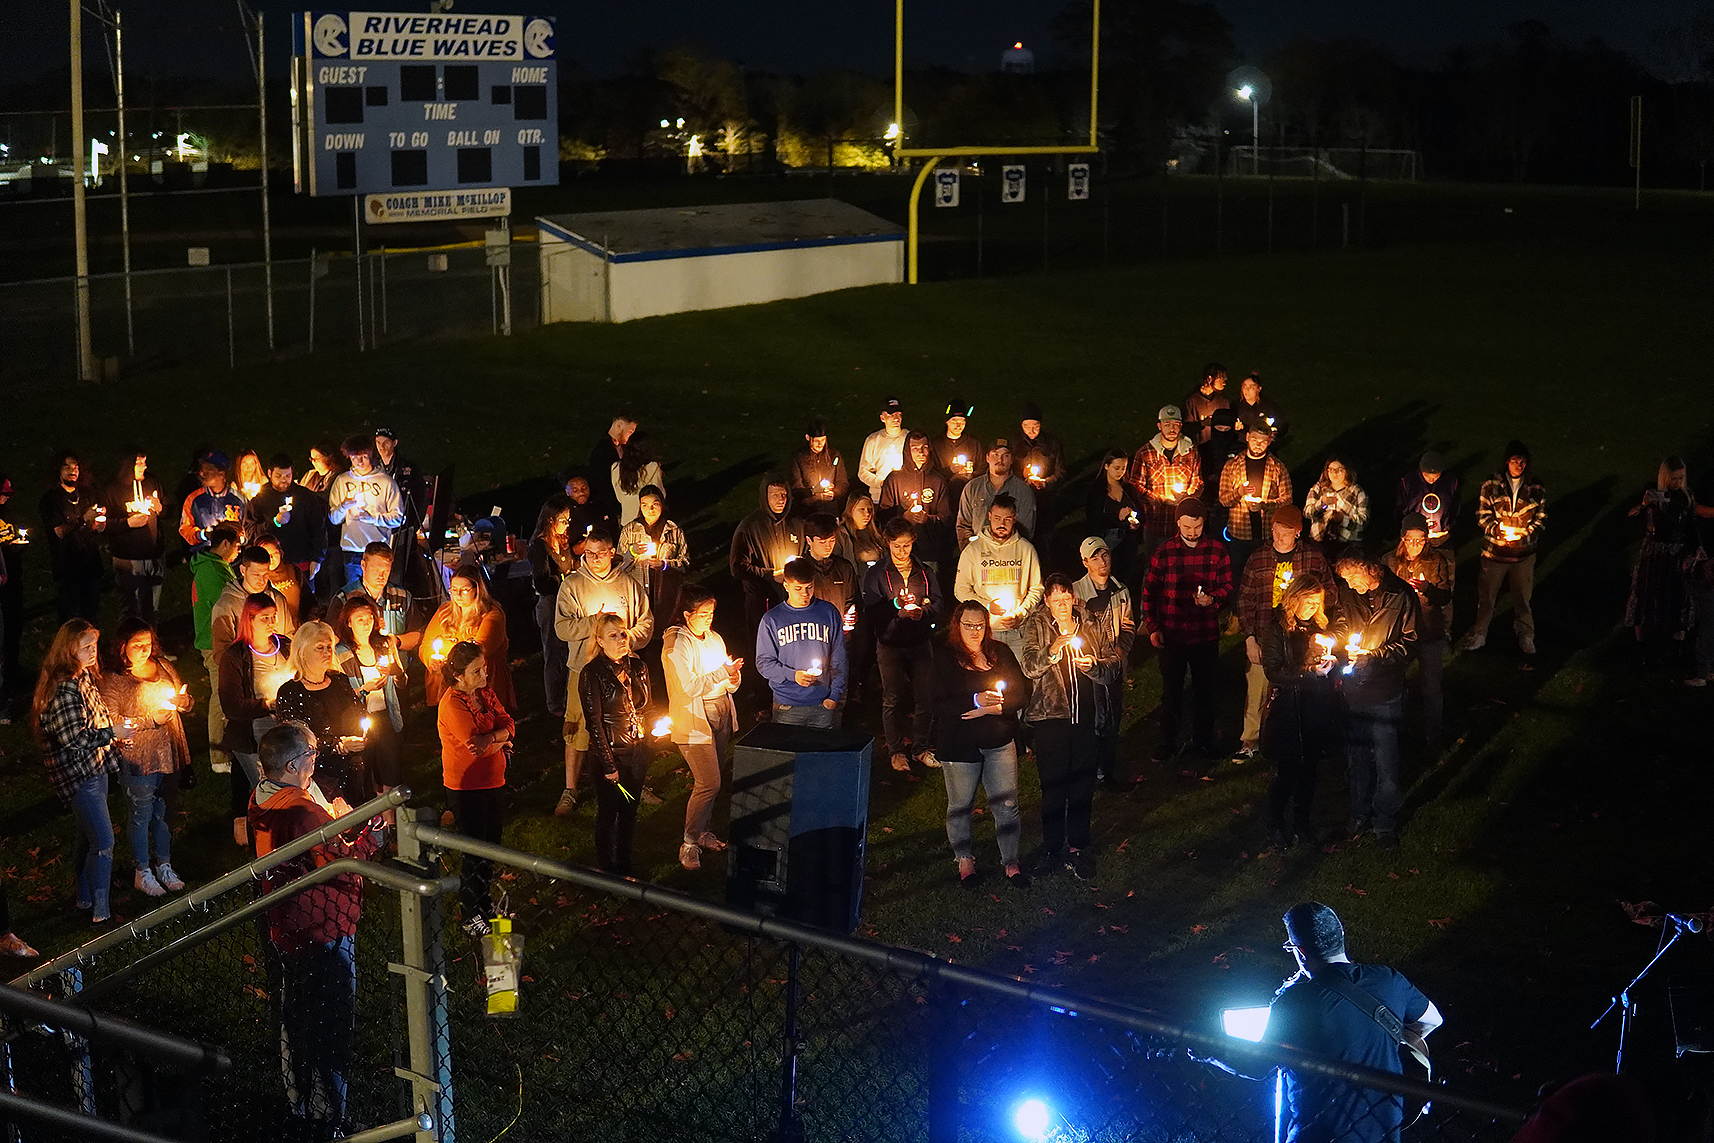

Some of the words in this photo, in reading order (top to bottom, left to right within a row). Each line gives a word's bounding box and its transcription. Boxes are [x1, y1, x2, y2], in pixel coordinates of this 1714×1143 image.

[363, 16, 510, 35] RIVERHEAD
[356, 38, 426, 56] BLUE
[433, 39, 518, 56] WAVES
[319, 66, 368, 84] GUEST
[511, 67, 549, 84] HOME
[423, 103, 458, 120] TIME
[325, 133, 365, 150] DOWN
[389, 132, 406, 148] TO
[411, 131, 429, 147] GO
[447, 130, 479, 146] BALL
[483, 129, 501, 145] ON
[517, 128, 546, 145] QTR.
[386, 196, 419, 210] COACH
[456, 192, 507, 206] McKILLOP
[405, 207, 459, 217] MEMORIAL
[461, 206, 488, 215] FIELD
[989, 558, 1022, 567] Polaroid
[777, 622, 830, 647] SUFFOLK
